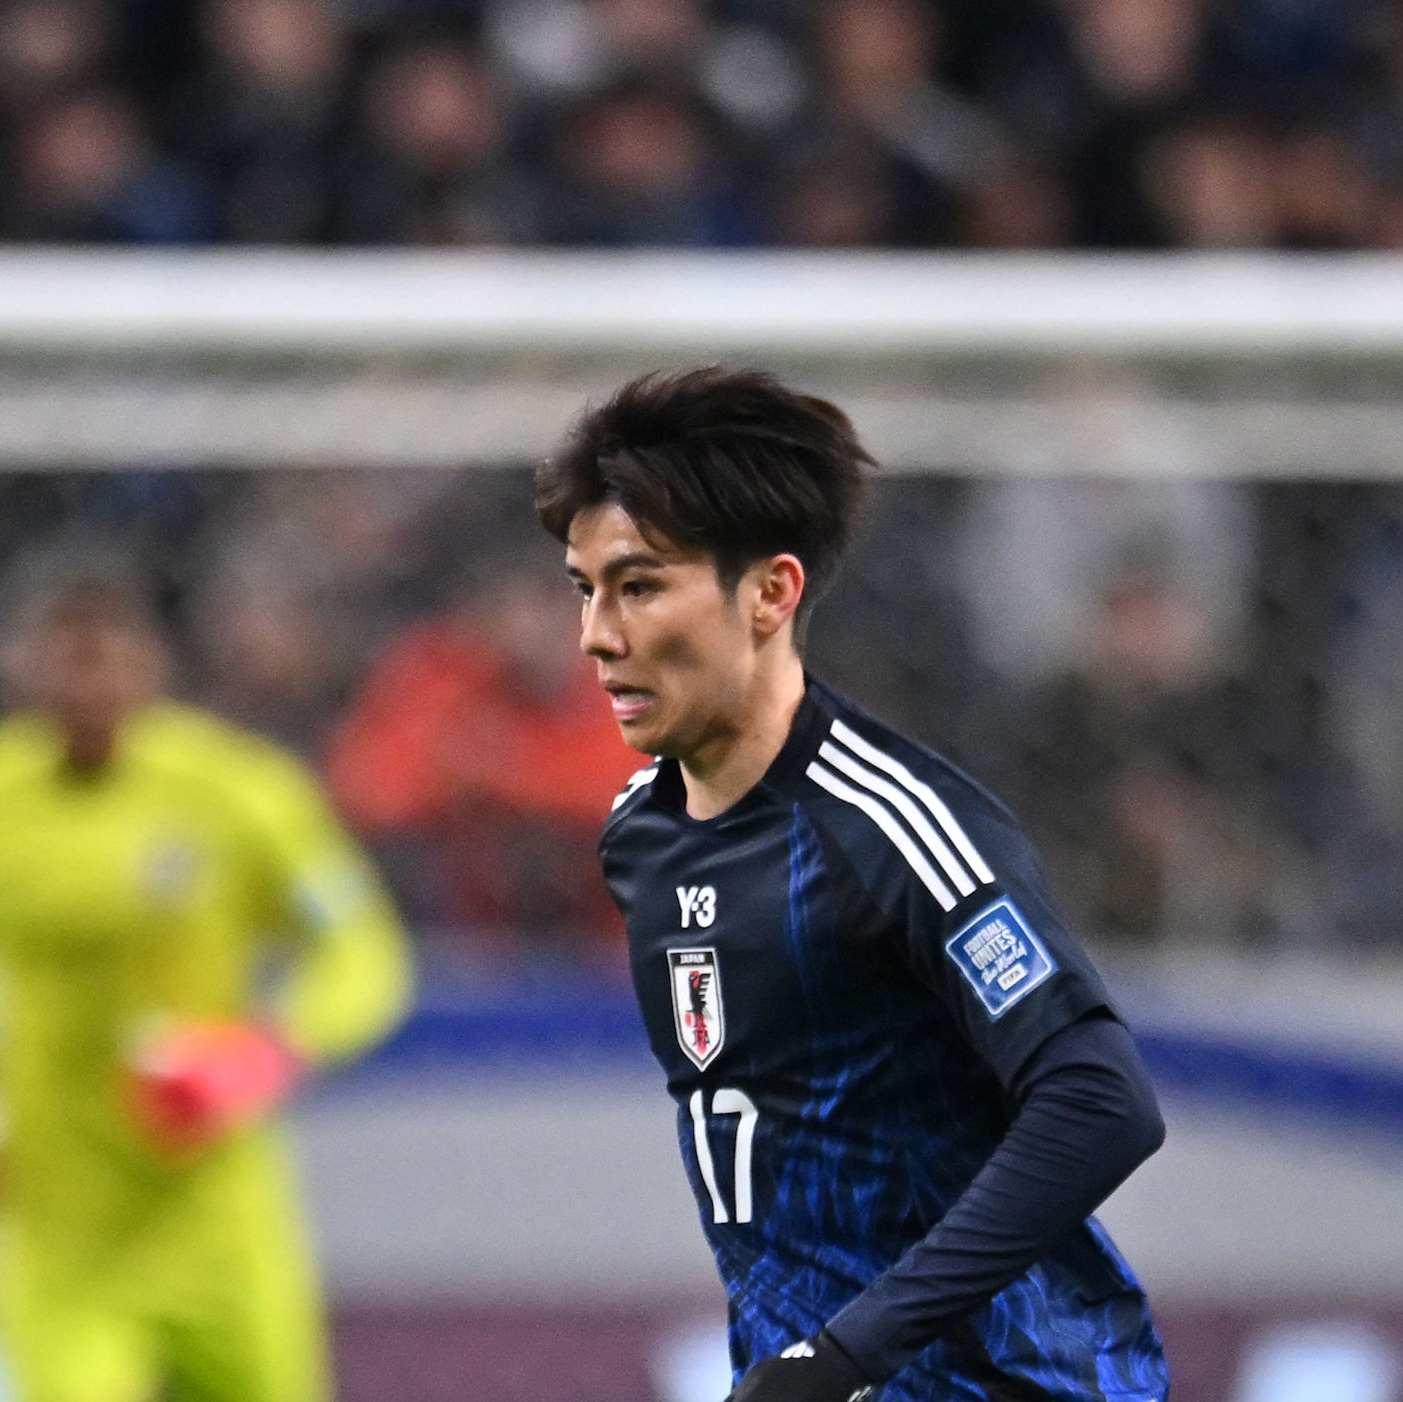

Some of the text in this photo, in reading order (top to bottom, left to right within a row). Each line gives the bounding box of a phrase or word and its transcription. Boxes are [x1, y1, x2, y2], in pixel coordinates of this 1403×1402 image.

[676, 886, 716, 928] Y-3
[971, 929, 1017, 970] UNITES
[689, 1088, 758, 1224] 17
